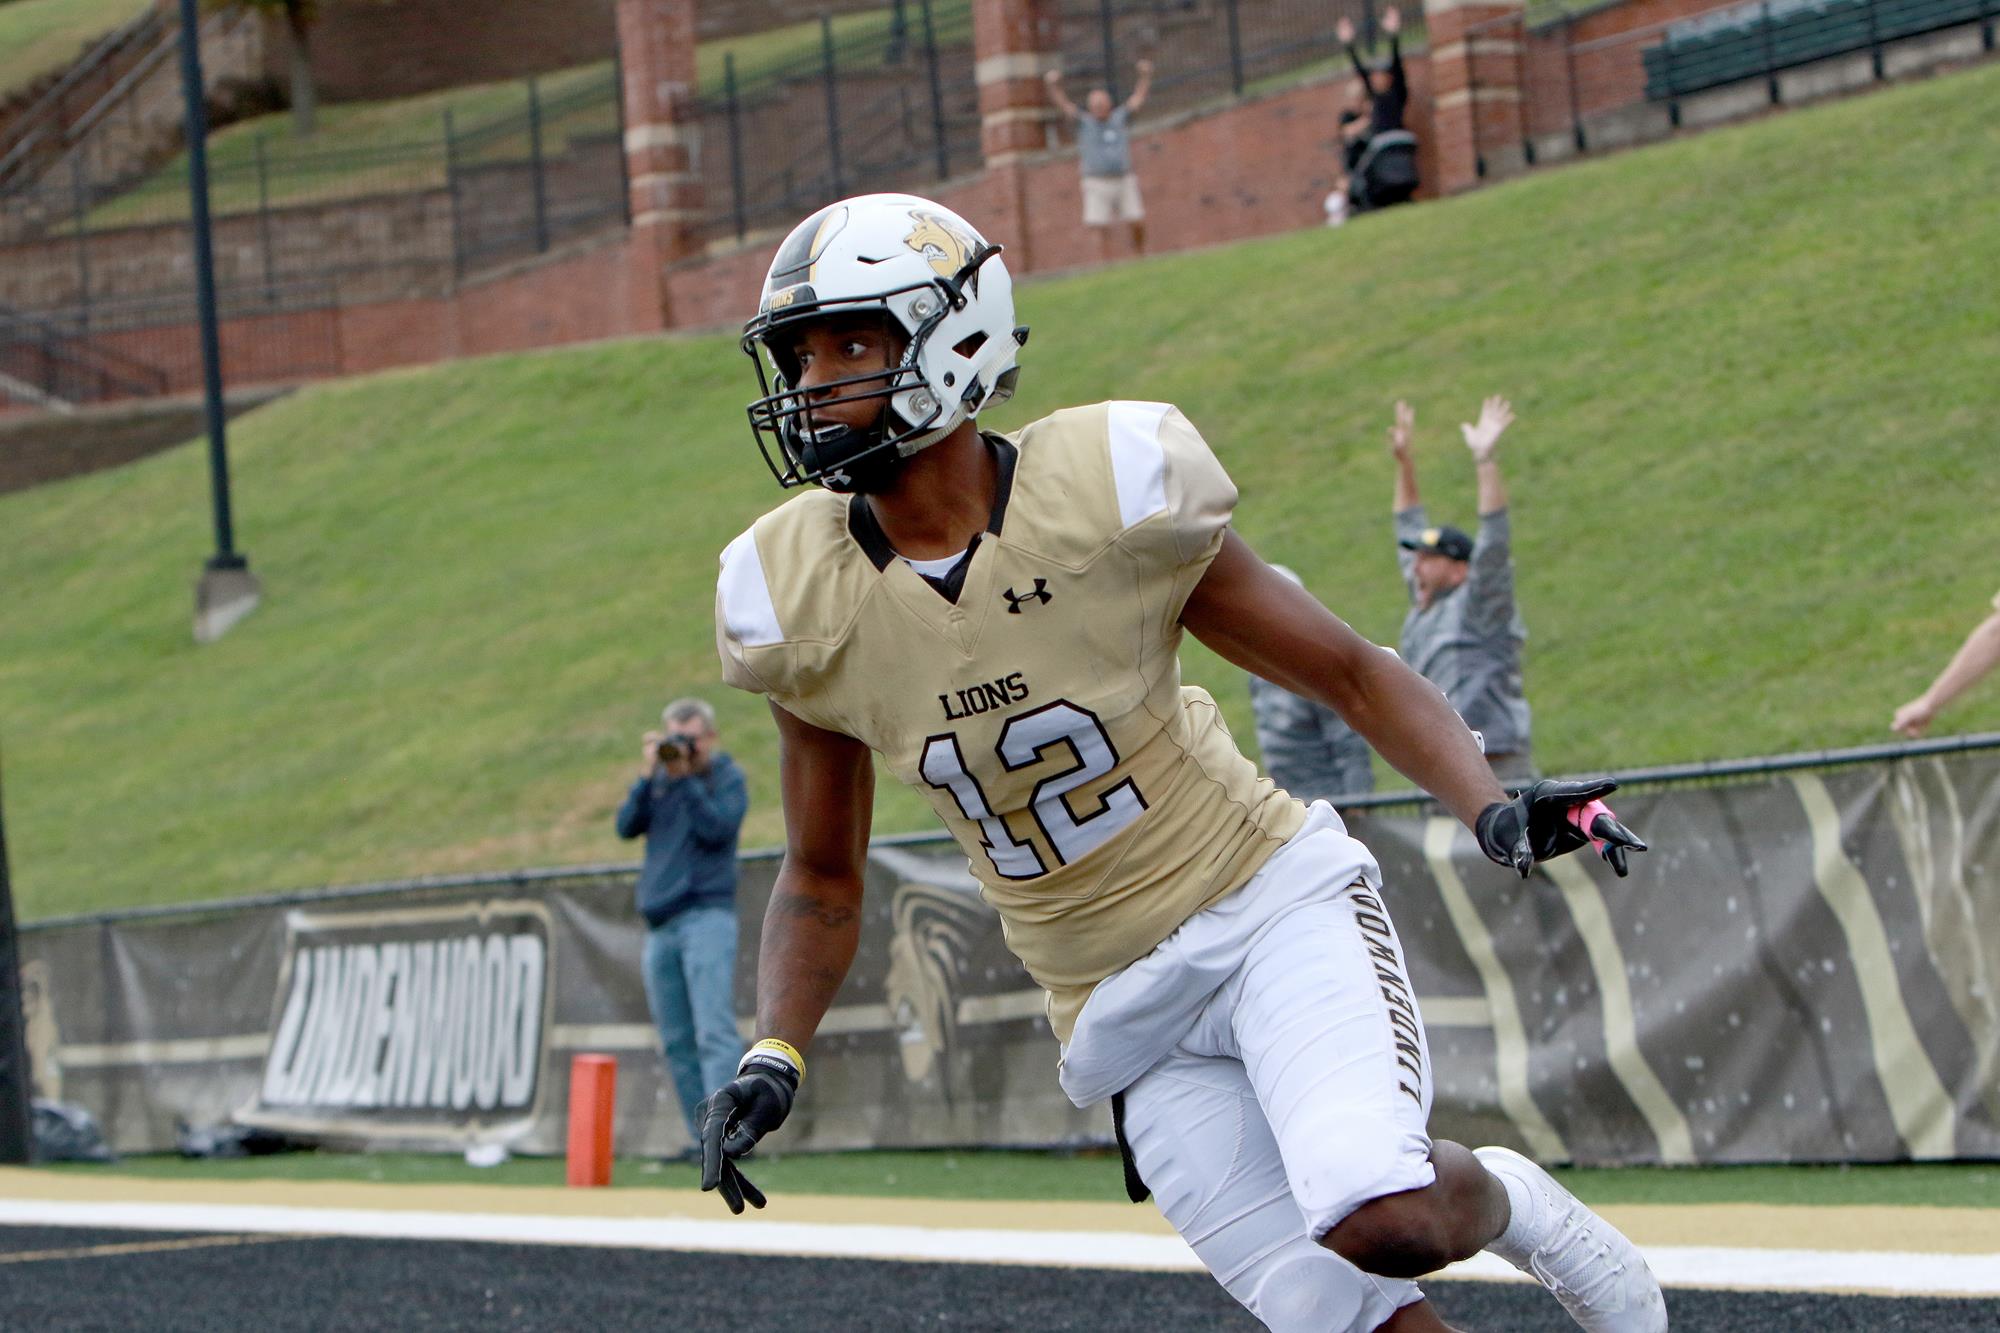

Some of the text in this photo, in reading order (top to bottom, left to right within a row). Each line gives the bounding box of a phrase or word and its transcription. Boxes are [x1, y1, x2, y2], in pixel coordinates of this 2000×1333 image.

[938, 672, 1029, 721] LIONS
[918, 698, 1150, 880] 12
[261, 934, 545, 1110] LINDENWOOD
